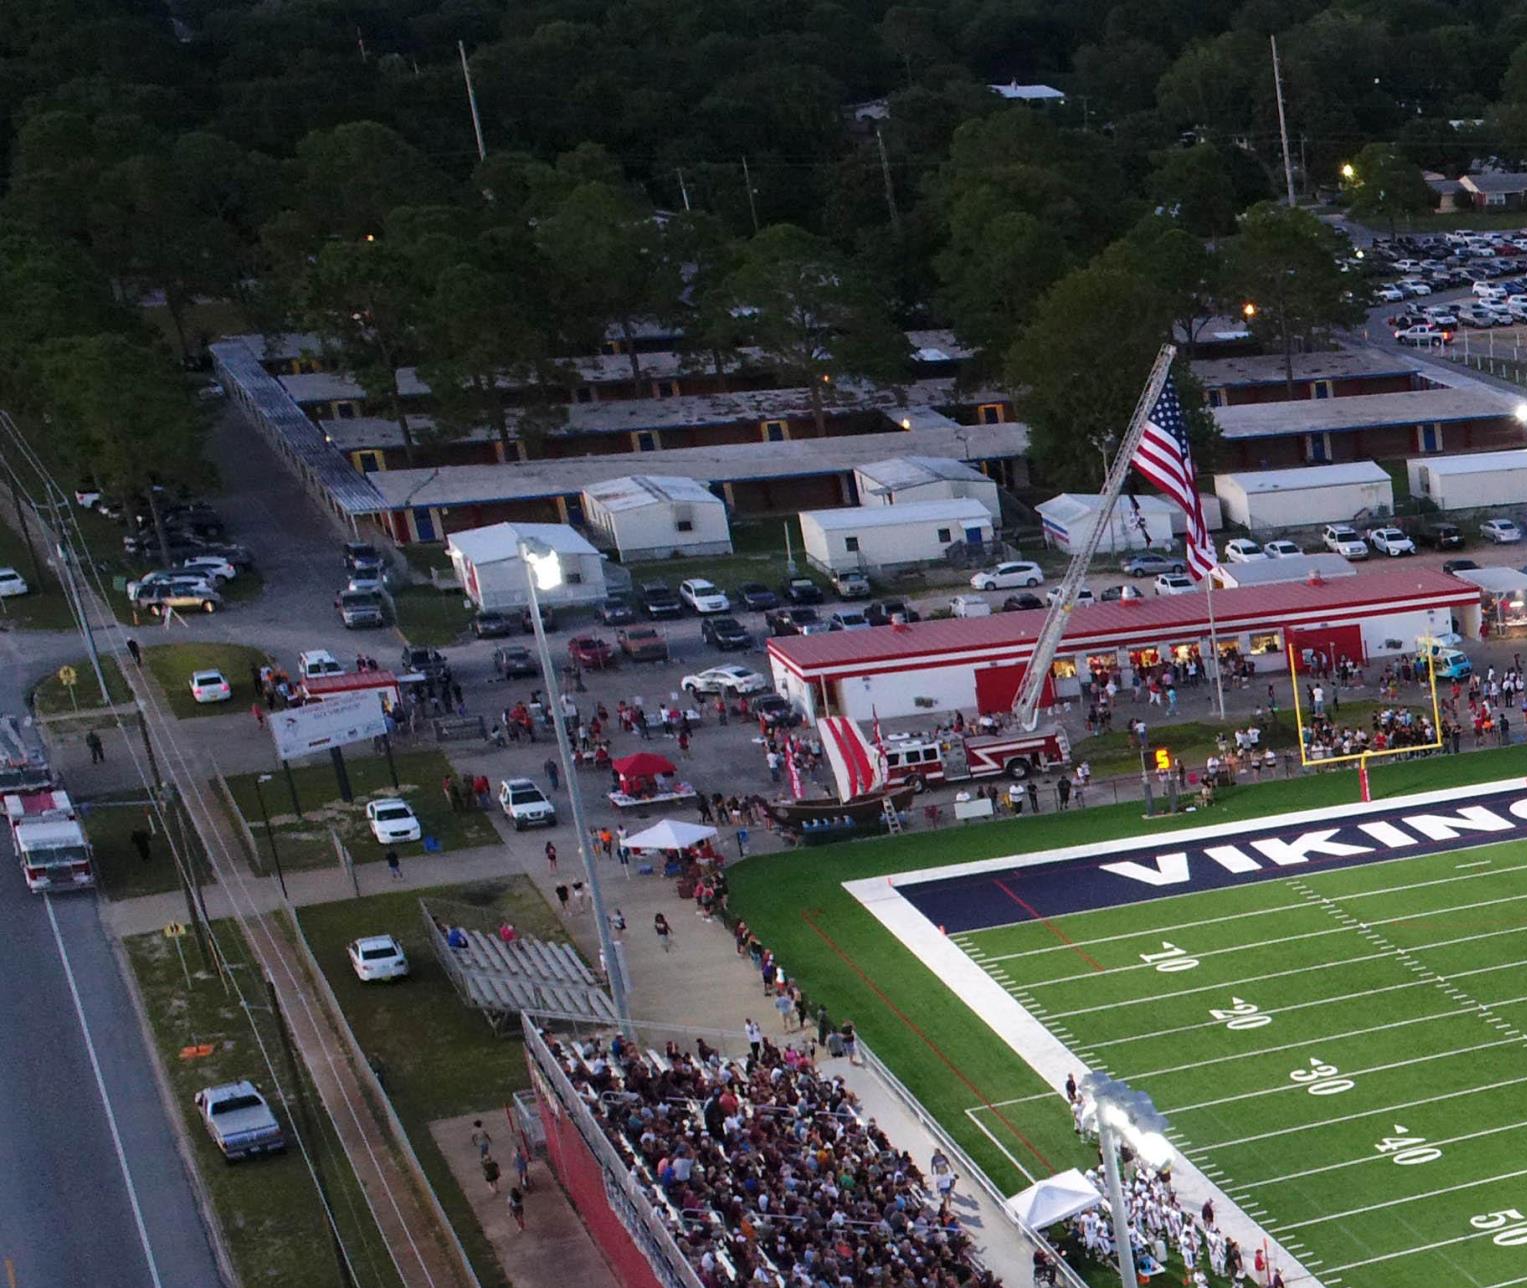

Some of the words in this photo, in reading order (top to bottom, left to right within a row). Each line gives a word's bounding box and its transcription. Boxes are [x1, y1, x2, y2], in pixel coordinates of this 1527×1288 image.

[1156, 749, 1170, 769] 5
[1139, 945, 1199, 973] 10
[1209, 1001, 1272, 1031] 20
[1290, 1064, 1354, 1096] 30
[1374, 1134, 1443, 1166] 40
